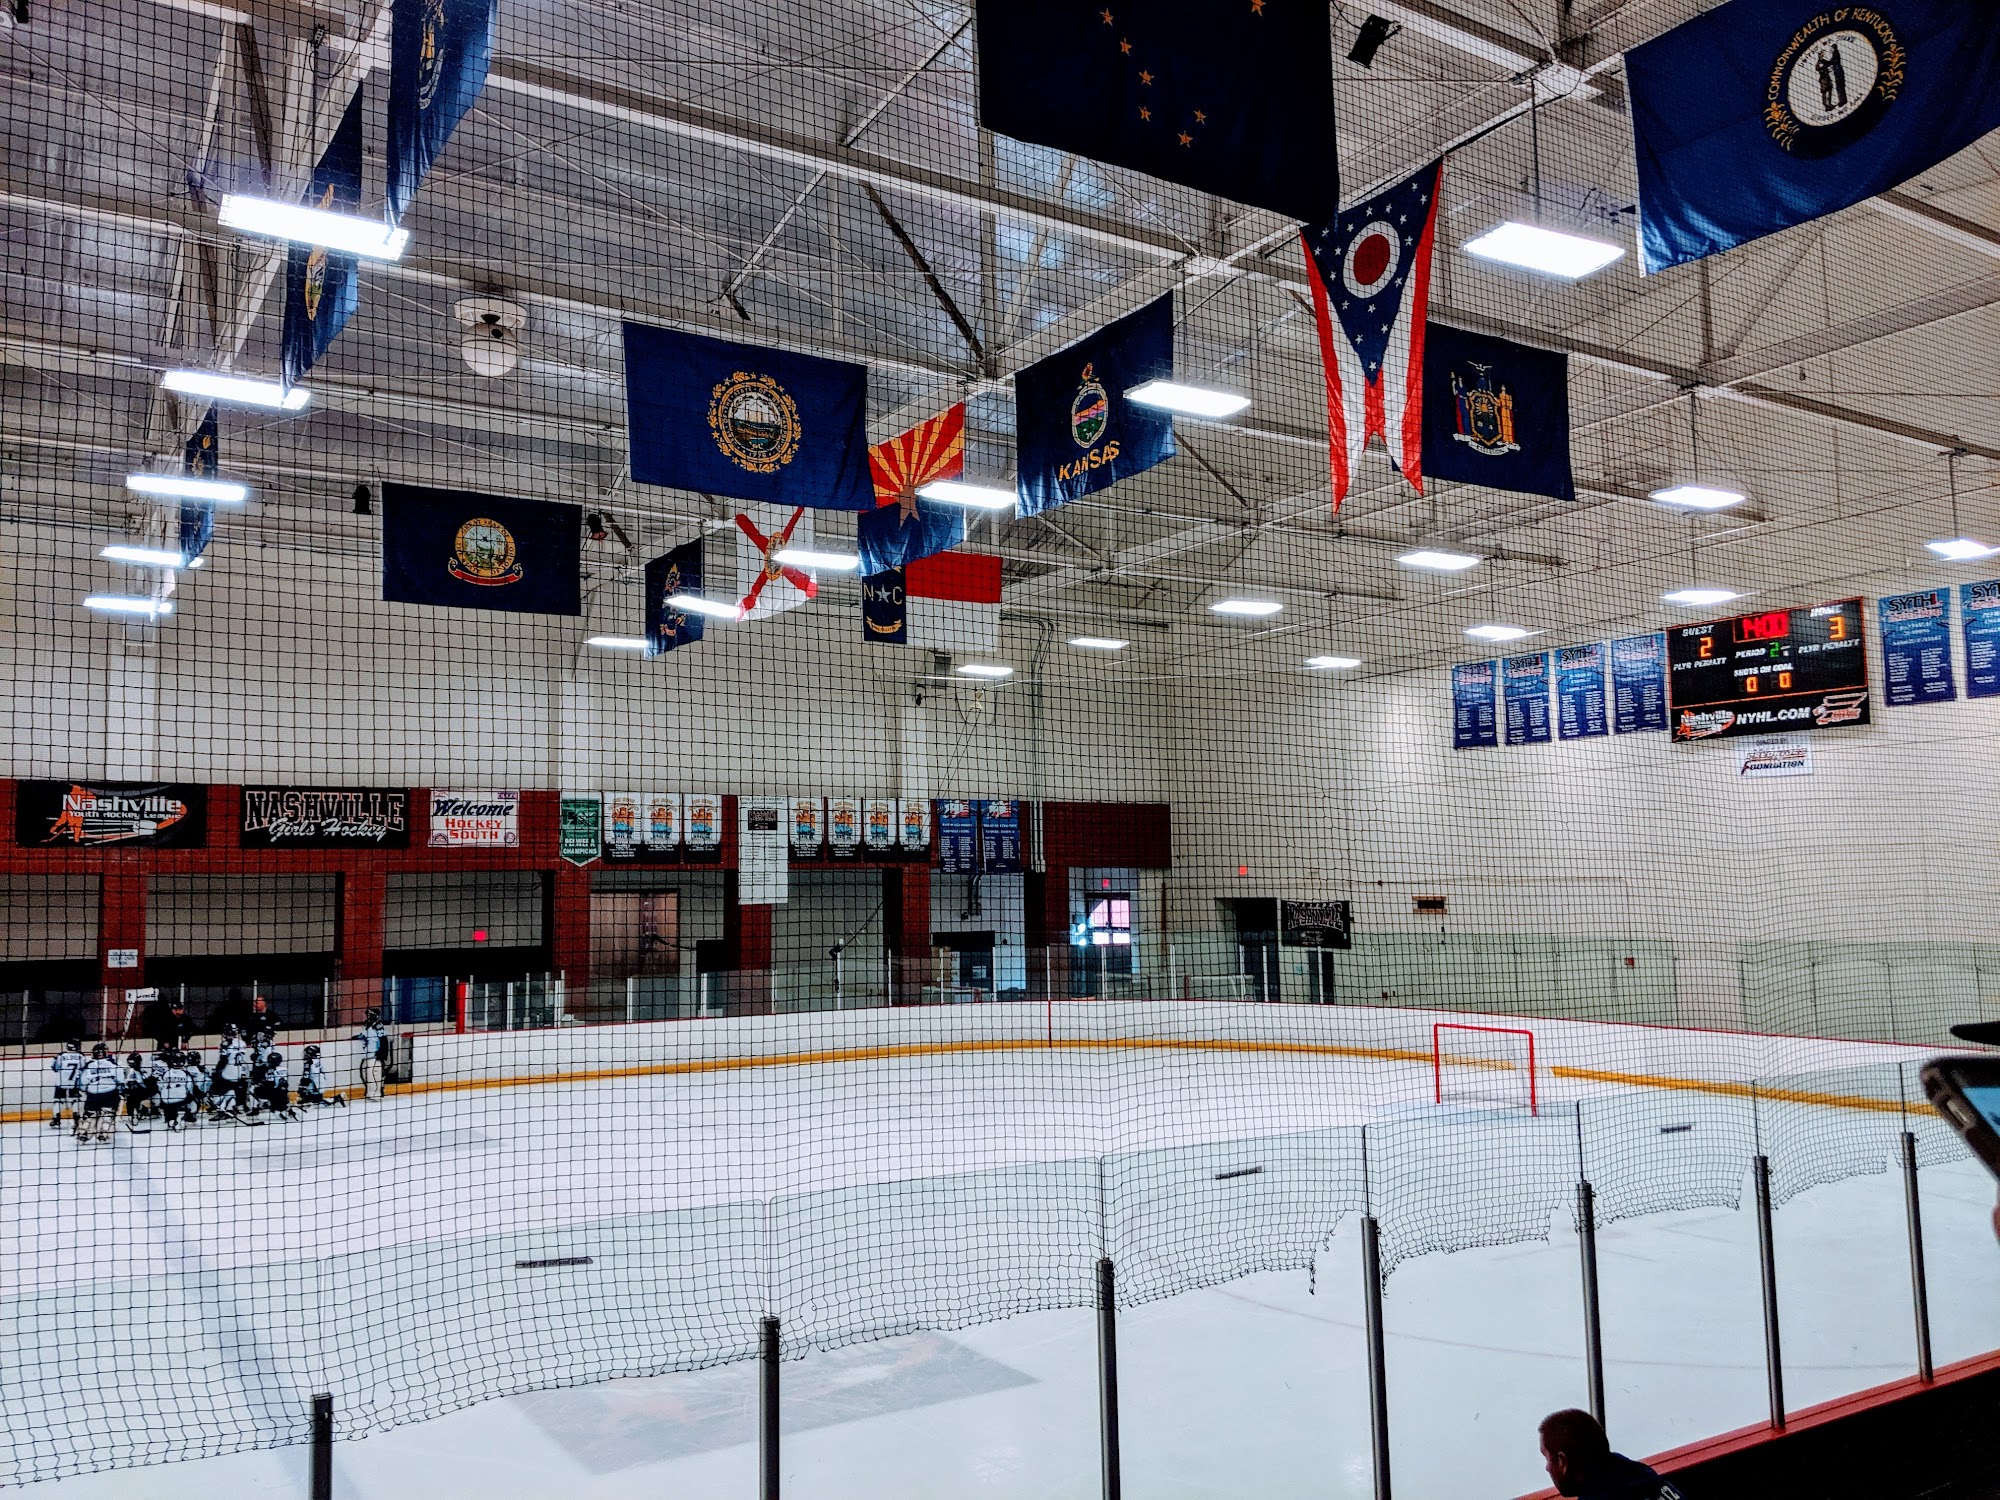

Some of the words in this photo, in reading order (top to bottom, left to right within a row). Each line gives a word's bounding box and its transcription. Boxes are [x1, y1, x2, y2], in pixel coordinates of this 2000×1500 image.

[1768, 13, 1831, 101] COMMONWEALTH
[1834, 7, 1850, 23] OF
[1852, 7, 1898, 45] KENTUCKY
[1059, 440, 1121, 482] KANSAS
[1810, 604, 1844, 617] HOME
[1682, 624, 1714, 637] GUEST
[1828, 616, 1846, 640] 3
[1699, 636, 1713, 658] 2
[1734, 647, 1767, 659] PERIOD
[1769, 641, 1779, 658] 2
[1798, 644, 1821, 654] PLYR
[1822, 638, 1860, 651] PENALTY
[1673, 661, 1692, 671] PLYR
[1694, 657, 1727, 669] PENALTY
[1733, 667, 1759, 677] SHOTS
[1760, 665, 1772, 674] ON
[1773, 662, 1794, 672] GOAL
[1746, 676, 1759, 693] 0
[1779, 672, 1792, 689] 0
[1681, 710, 1734, 723] Nashville
[1736, 706, 1811, 725] NYHL.COM
[1741, 761, 1805, 775] FOUNDATION
[63, 794, 182, 812] Nashville
[245, 791, 405, 831] NASHVILLE
[433, 798, 515, 817] Welcome
[69, 810, 100, 819] Youth
[103, 811, 140, 820] Hockey
[144, 811, 185, 820] League
[269, 818, 316, 843] Girls
[321, 818, 388, 843] Hockey
[1287, 901, 1346, 932] NASHVILLE
[68, 1062, 78, 1081] 7
